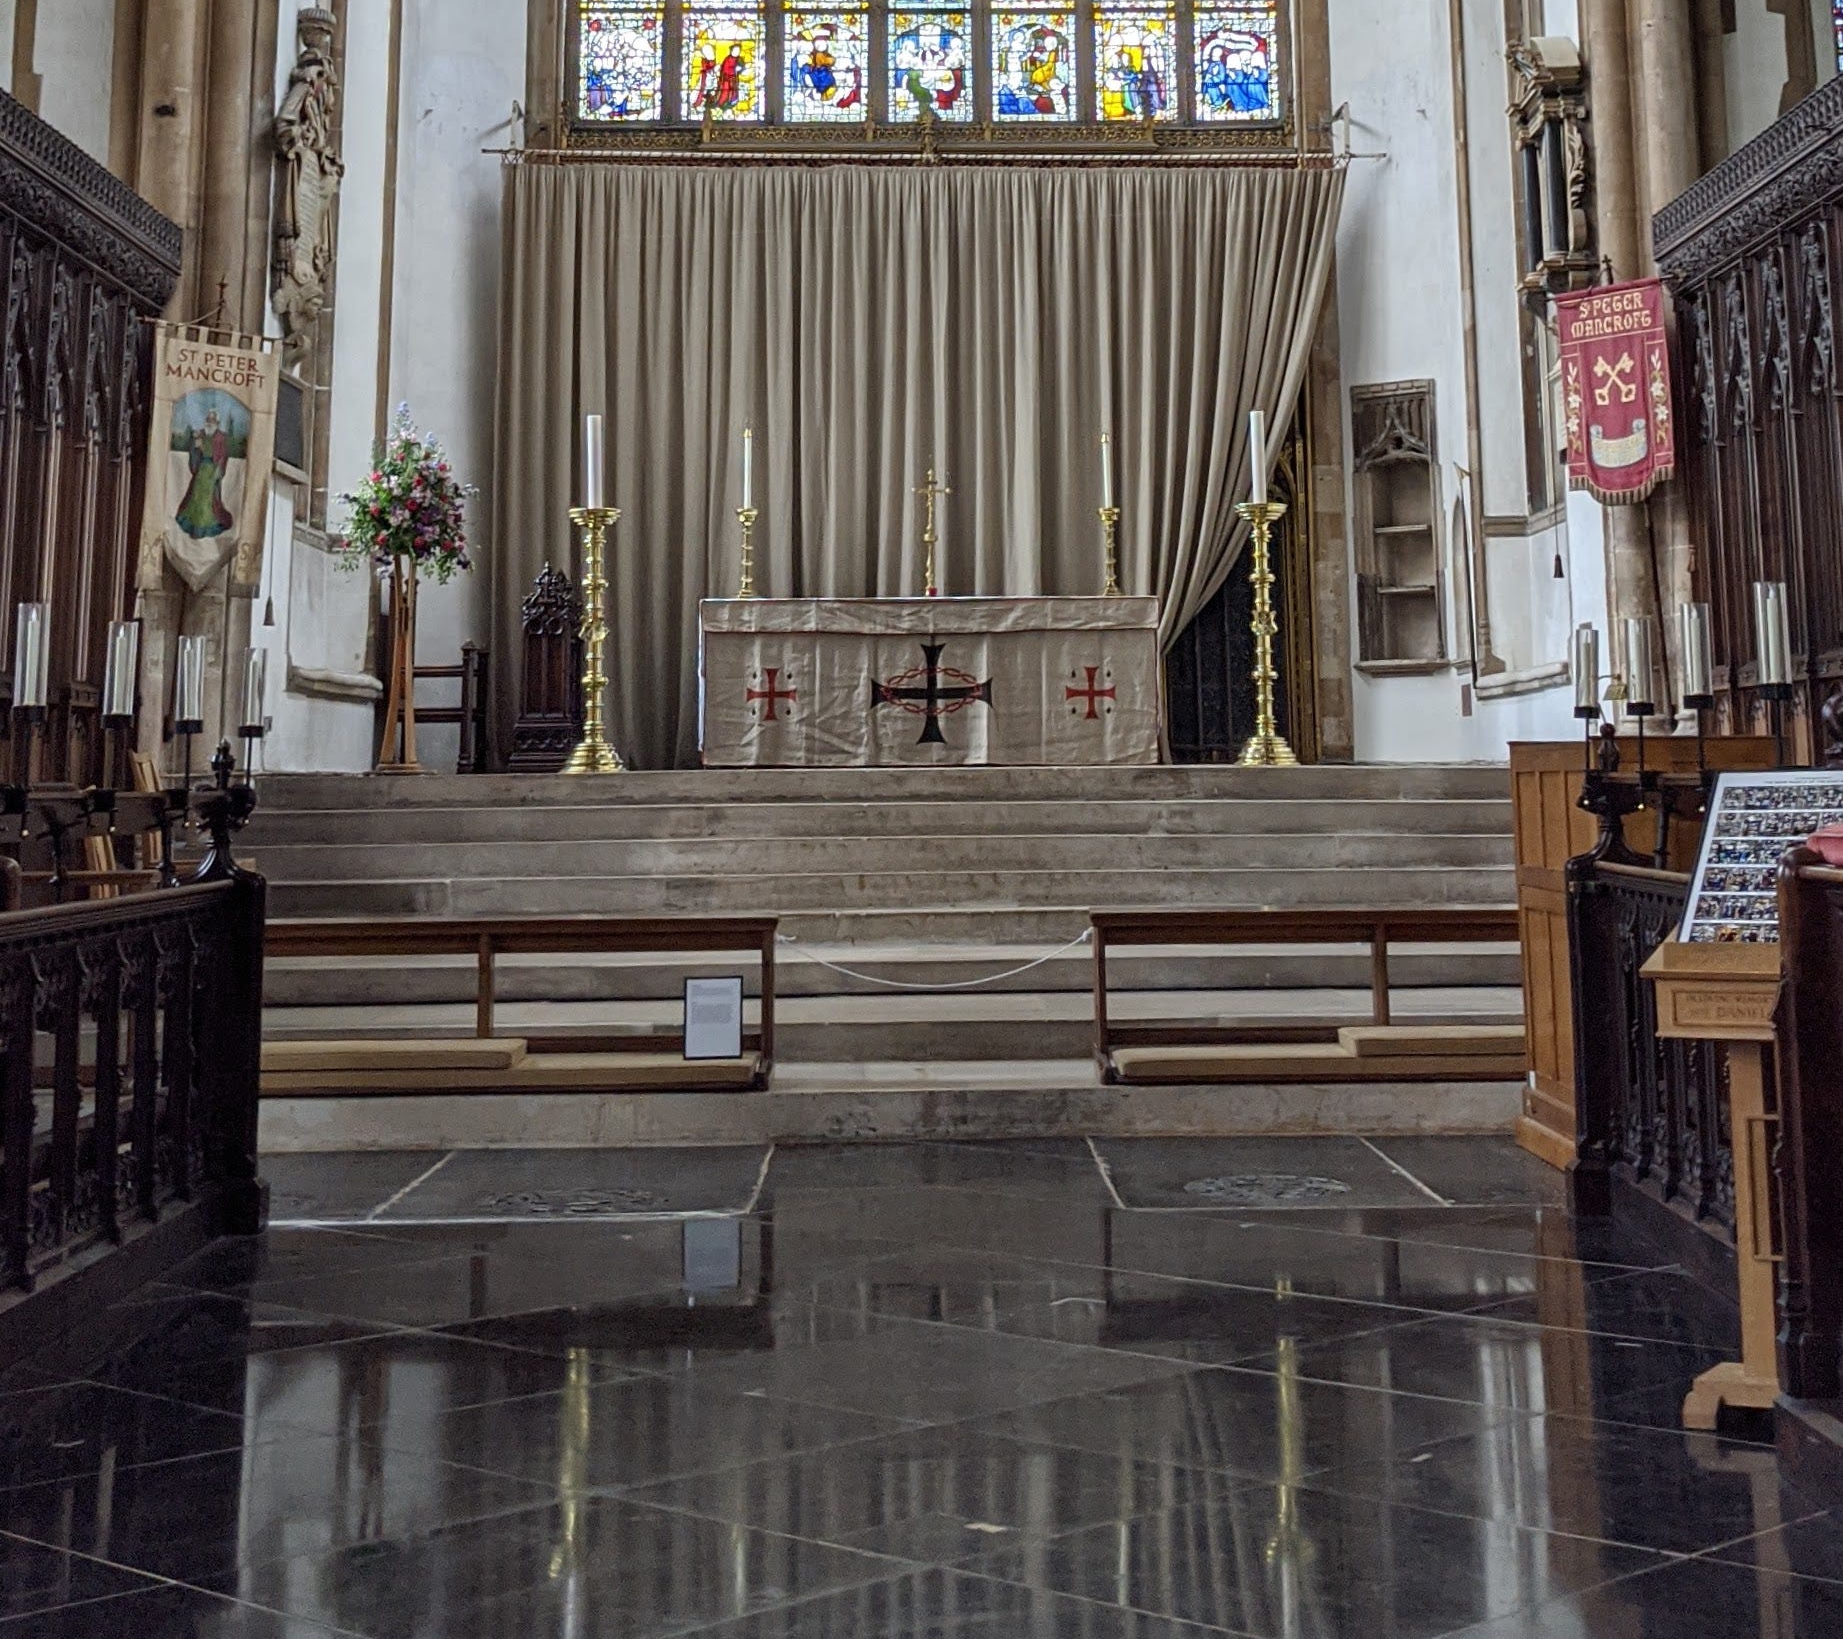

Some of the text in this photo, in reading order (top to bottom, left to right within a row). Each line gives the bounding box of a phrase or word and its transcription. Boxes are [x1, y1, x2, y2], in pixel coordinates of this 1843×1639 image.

[1592, 292, 1643, 317] PETER
[1571, 310, 1652, 338] MANCROFT
[178, 349, 259, 372] ST PETER
[165, 363, 265, 388] MANCROFT
